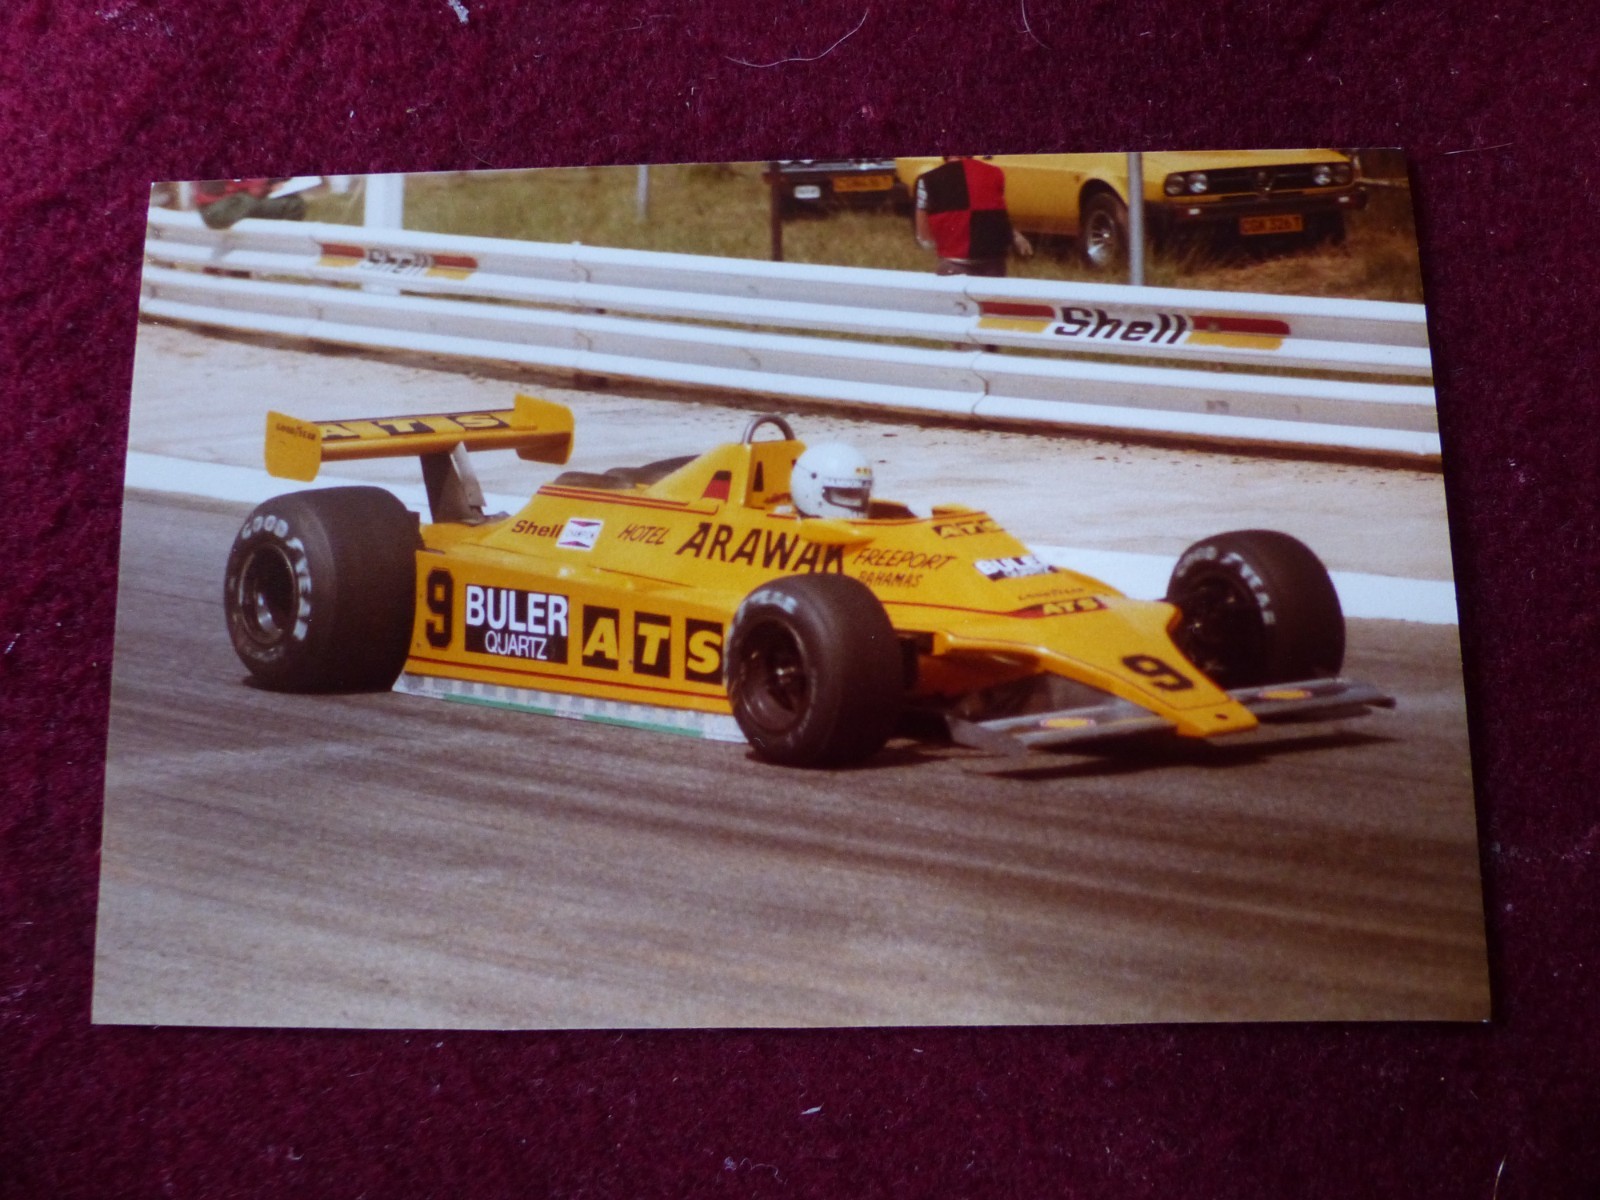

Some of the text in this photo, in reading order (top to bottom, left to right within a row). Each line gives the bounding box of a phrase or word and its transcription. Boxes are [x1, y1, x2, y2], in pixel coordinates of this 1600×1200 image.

[362, 247, 429, 274] Shell
[1055, 307, 1189, 345] Shell
[321, 414, 506, 438] ATS
[511, 519, 564, 540] Shell
[617, 522, 845, 575] HOTEL ARAWAK
[853, 547, 957, 572] FREEPORT
[857, 571, 924, 589] BAHAMAS
[425, 566, 455, 650] 9
[465, 585, 568, 637] BULER
[484, 630, 547, 661] QUARTZ
[582, 617, 722, 674] ATS
[1121, 654, 1194, 692] 9
